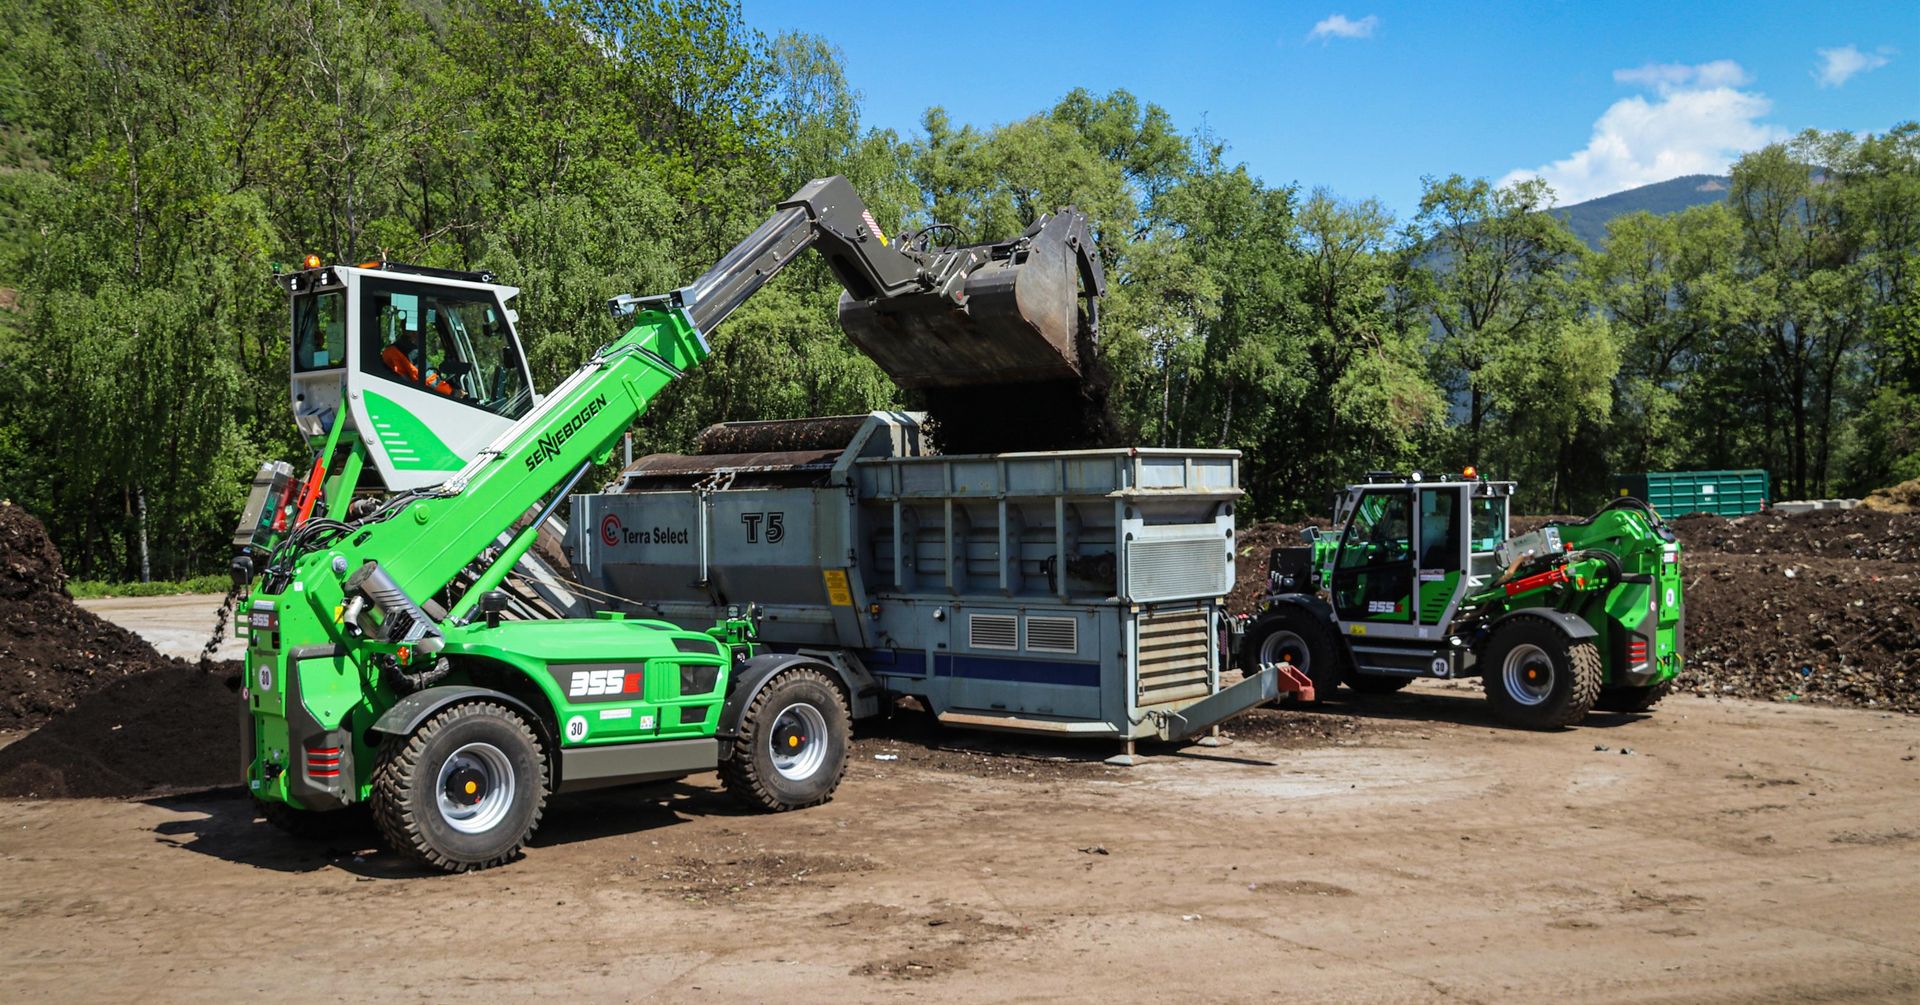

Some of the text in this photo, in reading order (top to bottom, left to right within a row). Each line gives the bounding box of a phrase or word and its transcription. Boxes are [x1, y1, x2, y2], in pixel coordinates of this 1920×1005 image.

[525, 393, 607, 472] SENNEBOGEN
[622, 527, 689, 544] Terra Select
[1435, 661, 1445, 672] 30
[569, 669, 642, 697] 355E
[571, 721, 583, 736] 30
